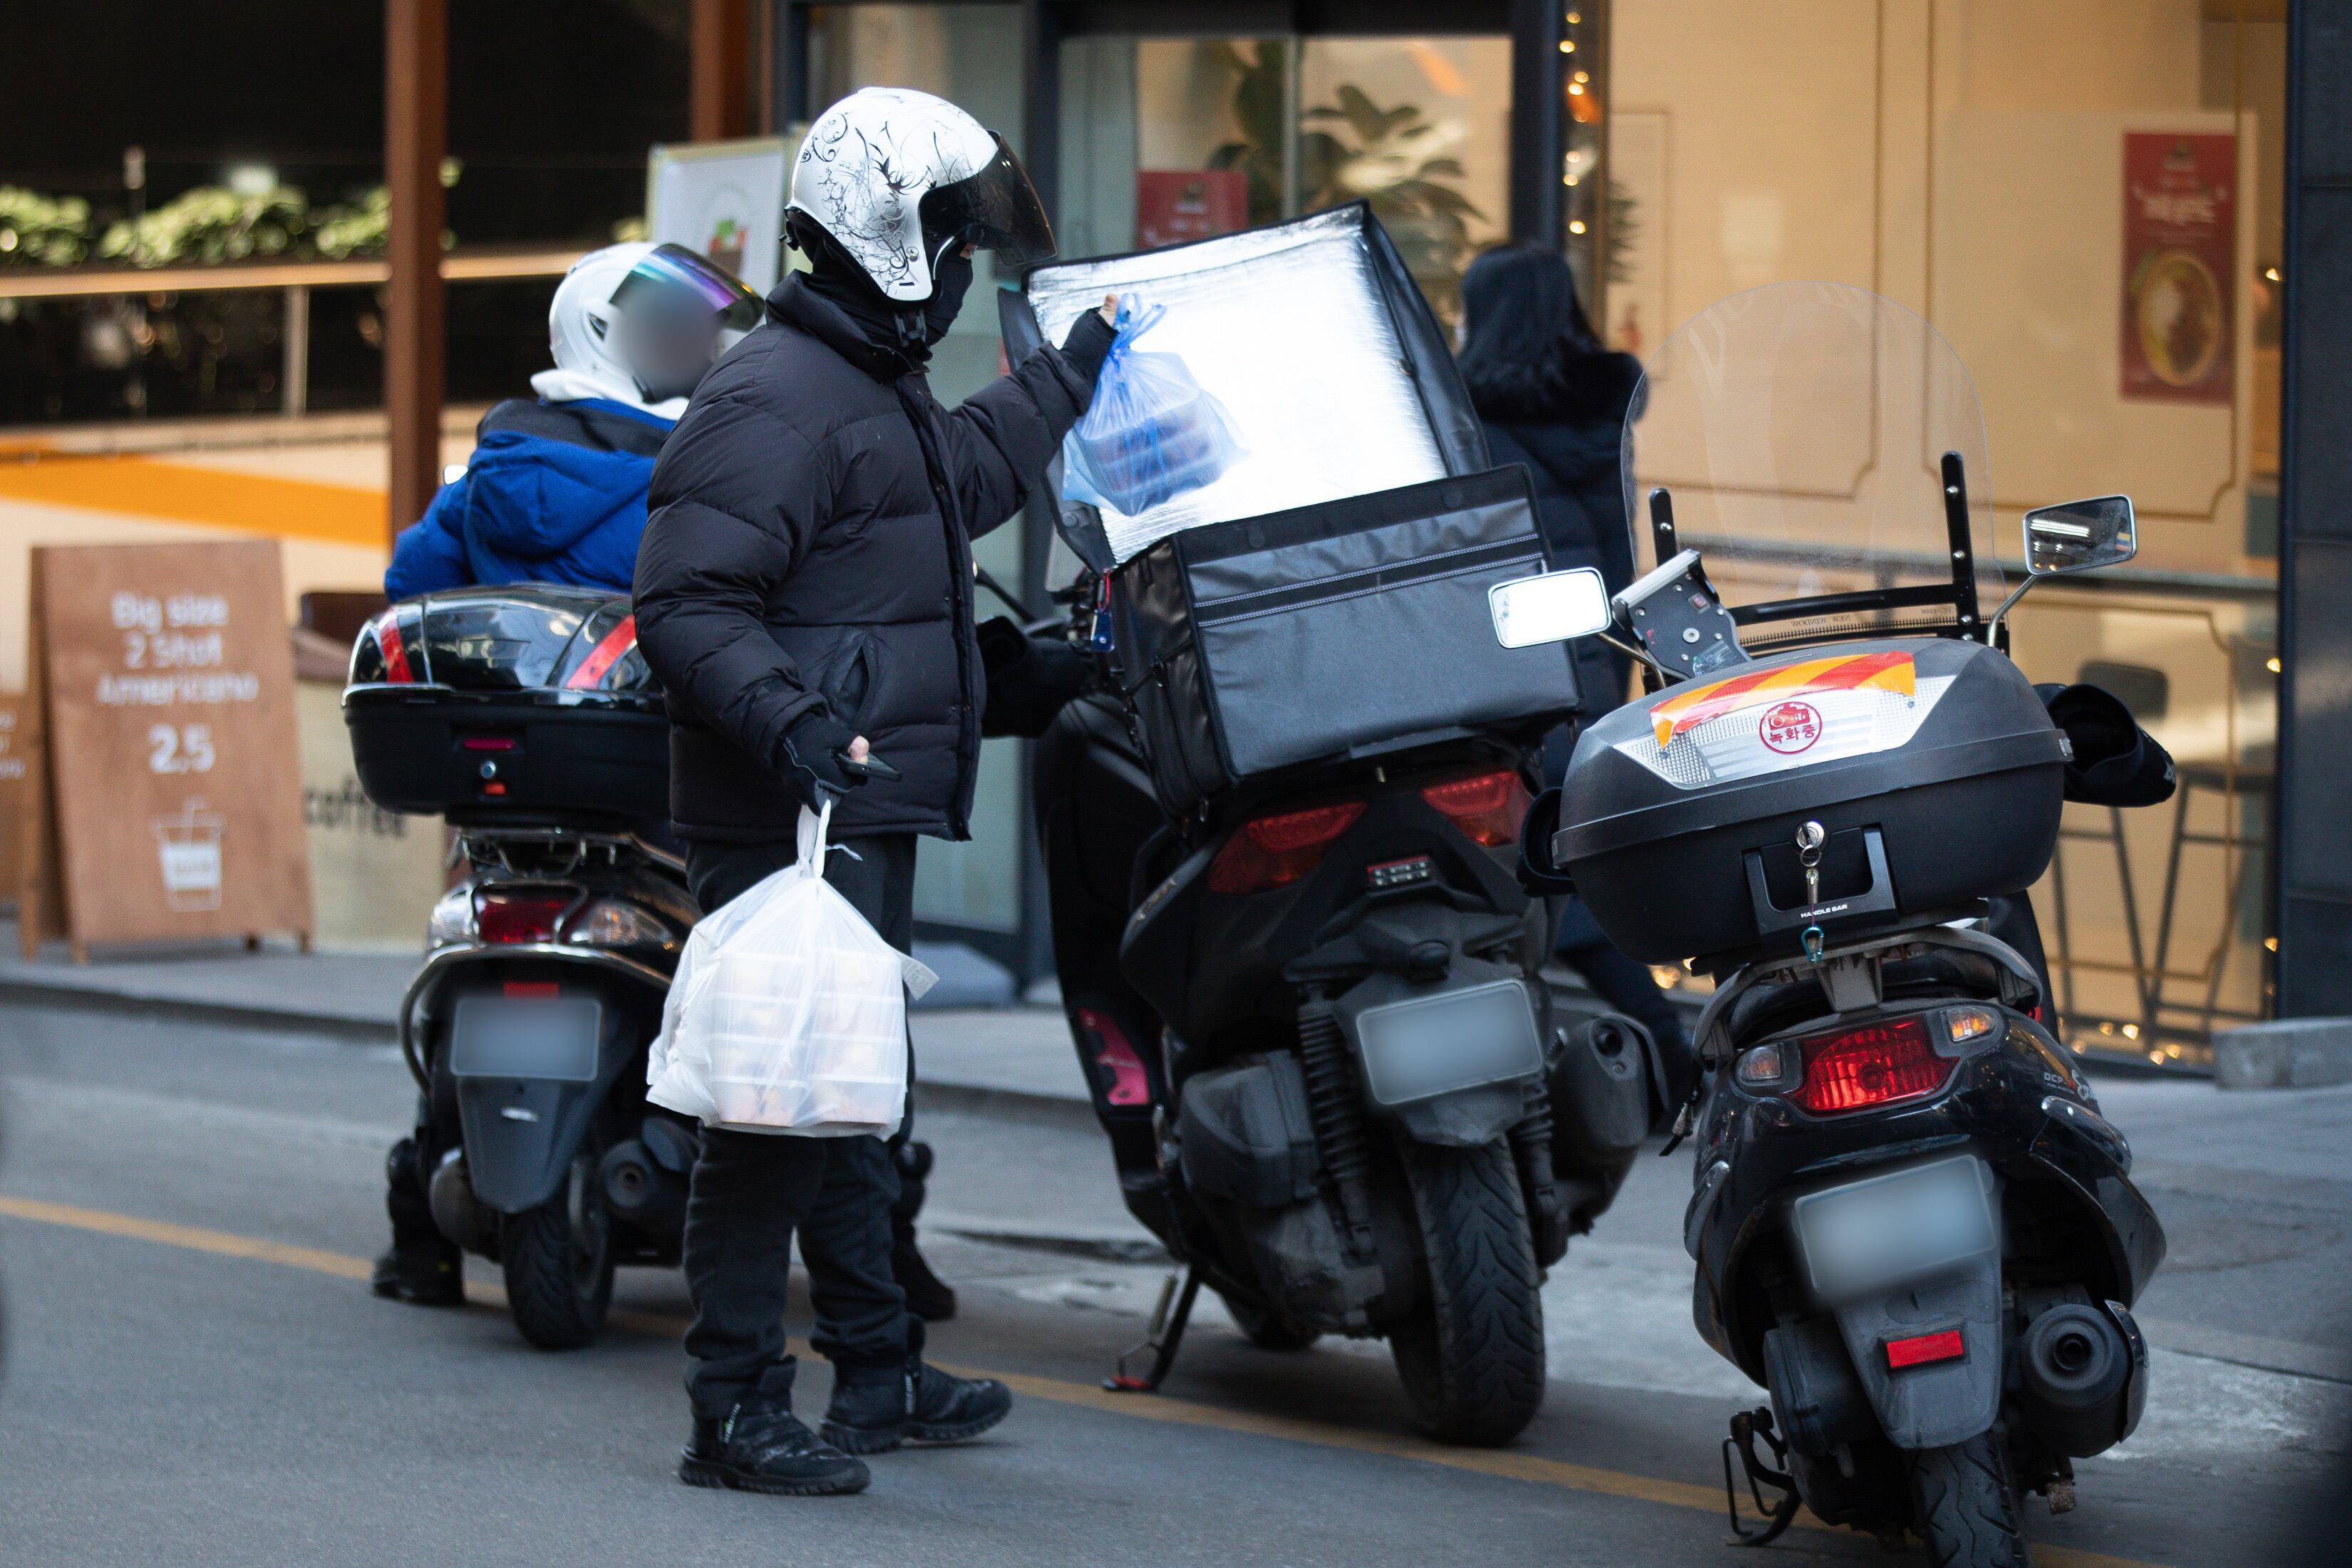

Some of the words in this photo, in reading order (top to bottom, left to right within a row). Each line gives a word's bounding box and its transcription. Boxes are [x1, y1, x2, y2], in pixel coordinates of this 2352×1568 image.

[111, 592, 163, 634] Big
[167, 593, 229, 627] size
[125, 632, 145, 669] 2
[98, 672, 259, 704] Americano
[149, 723, 215, 773] 2.5
[1769, 724, 1815, 743] 녹화중
[1800, 907, 1831, 918] HANDLE
[1831, 904, 1848, 912] BAR
